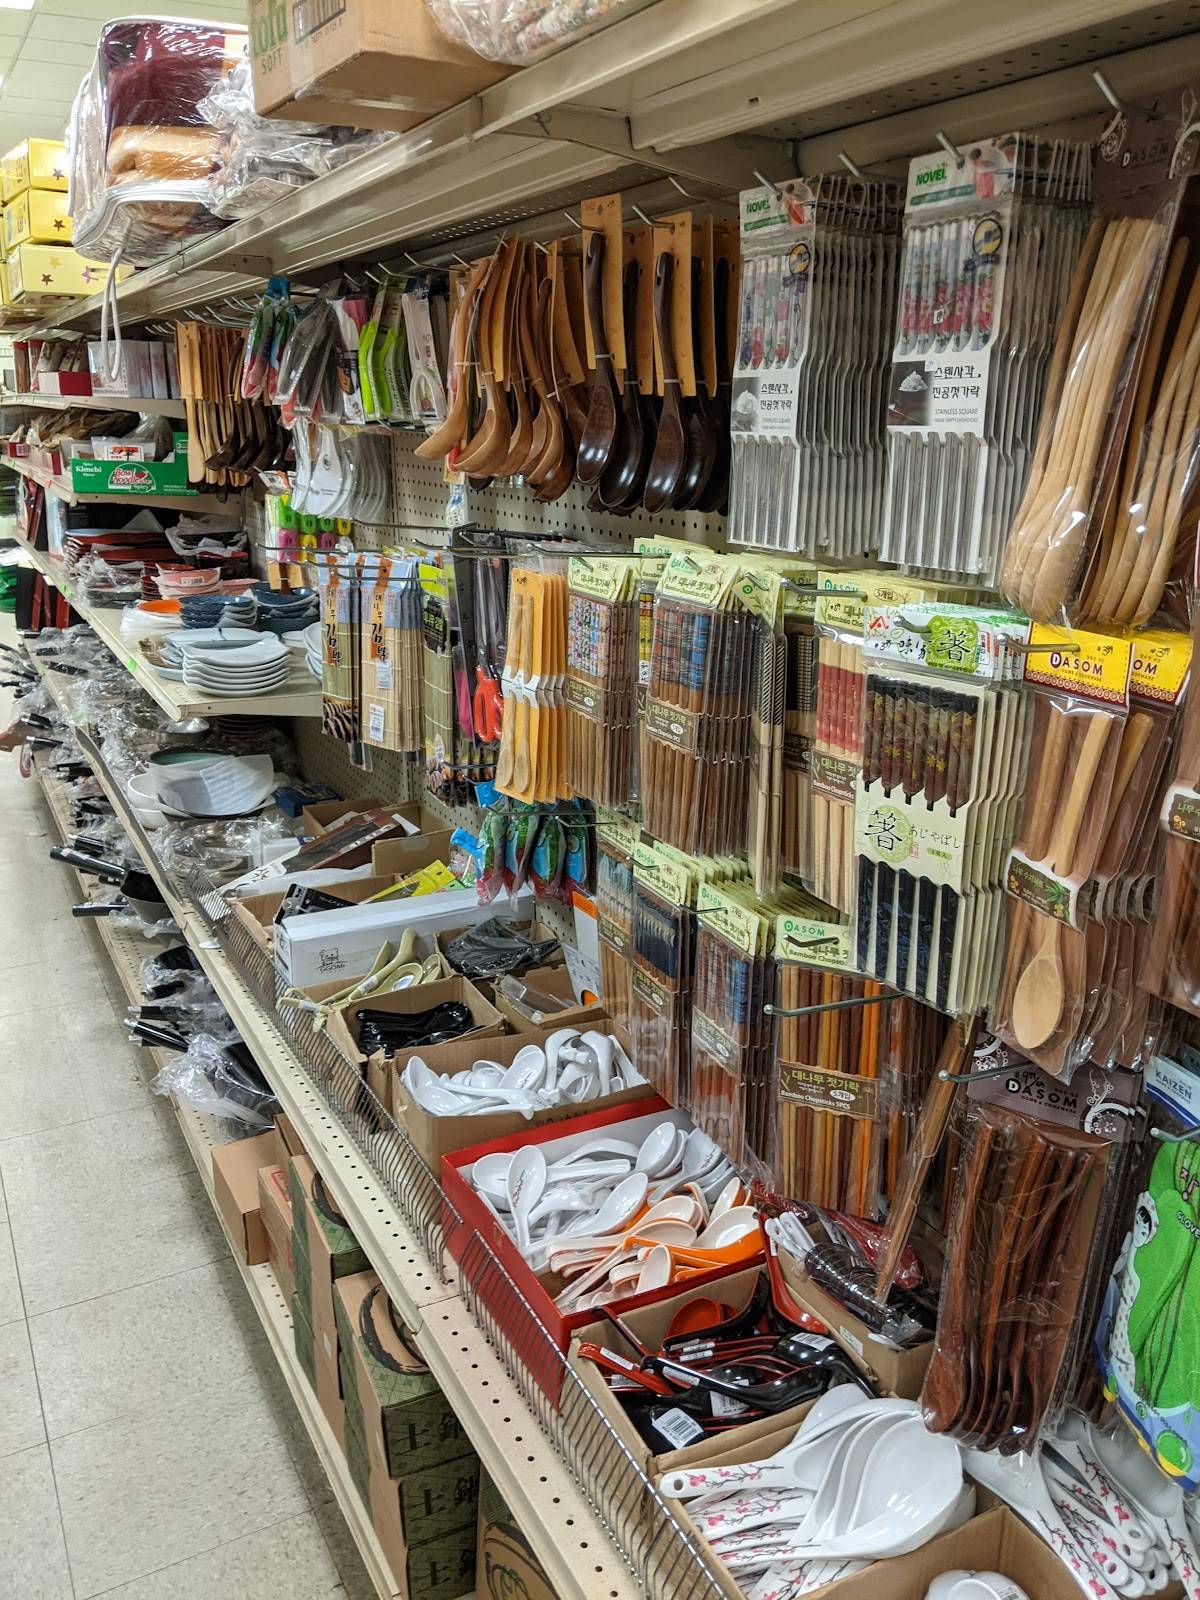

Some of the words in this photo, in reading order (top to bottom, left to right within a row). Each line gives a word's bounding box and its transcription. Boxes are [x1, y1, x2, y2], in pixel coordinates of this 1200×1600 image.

[261, 47, 283, 76] SOFT
[916, 167, 947, 186] NOVEL
[746, 199, 770, 214] NOVEL
[932, 386, 980, 399] 진공젓가락
[1050, 651, 1103, 676] DASOM
[821, 757, 846, 774] 대나무
[784, 920, 825, 937] DASOM
[789, 949, 817, 960] Bamboo
[791, 1070, 825, 1085] 대나무
[826, 1077, 860, 1093] 젓가락
[1155, 1069, 1193, 1100] KAIZEN
[780, 1089, 805, 1100] Bamboo
[1005, 1078, 1078, 1109] DASOM
